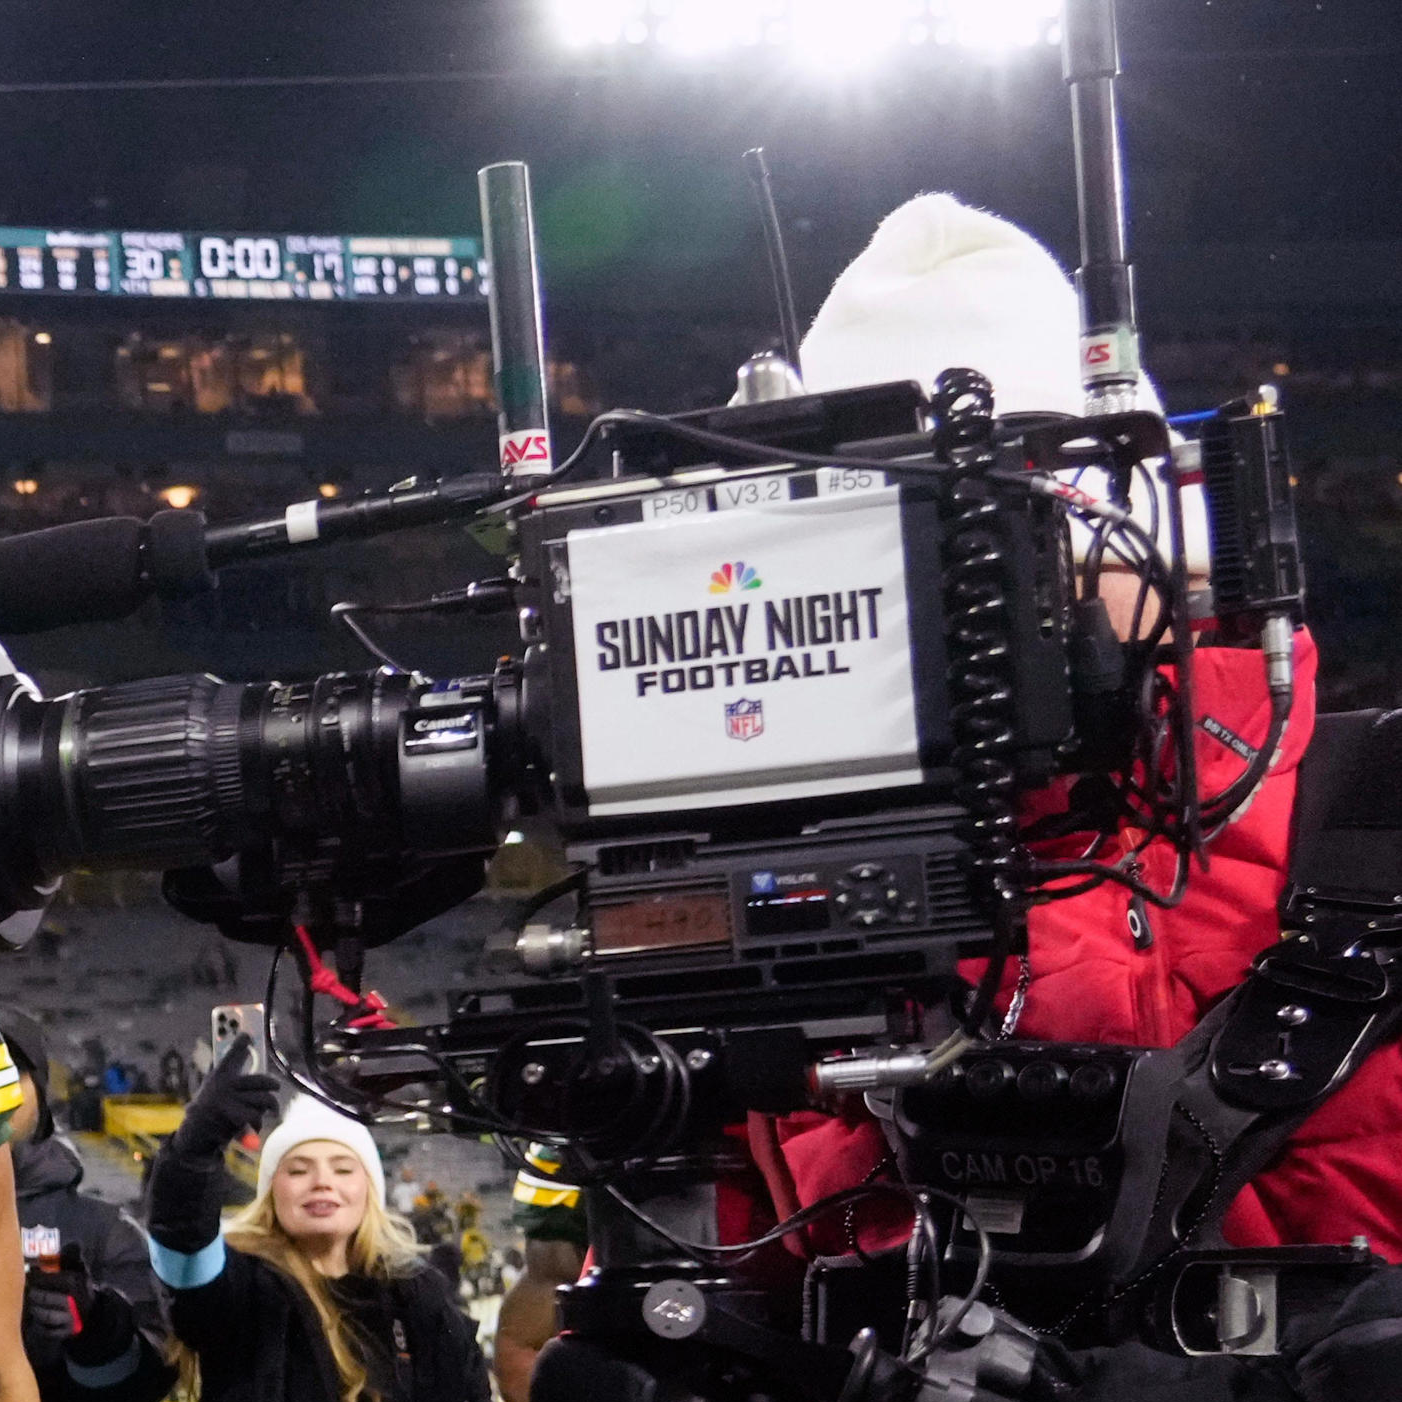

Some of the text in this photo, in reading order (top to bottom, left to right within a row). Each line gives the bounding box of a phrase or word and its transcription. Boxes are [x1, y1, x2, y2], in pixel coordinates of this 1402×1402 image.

[125, 249, 163, 280] 30
[200, 237, 280, 279] 0:00
[653, 470, 872, 517] P50 V3.2 #55
[597, 588, 883, 671] SUNDAY NIGHT
[636, 651, 850, 696] FOOTBALL
[729, 716, 762, 736] NFL
[942, 1152, 1103, 1187] CAM OP 16
